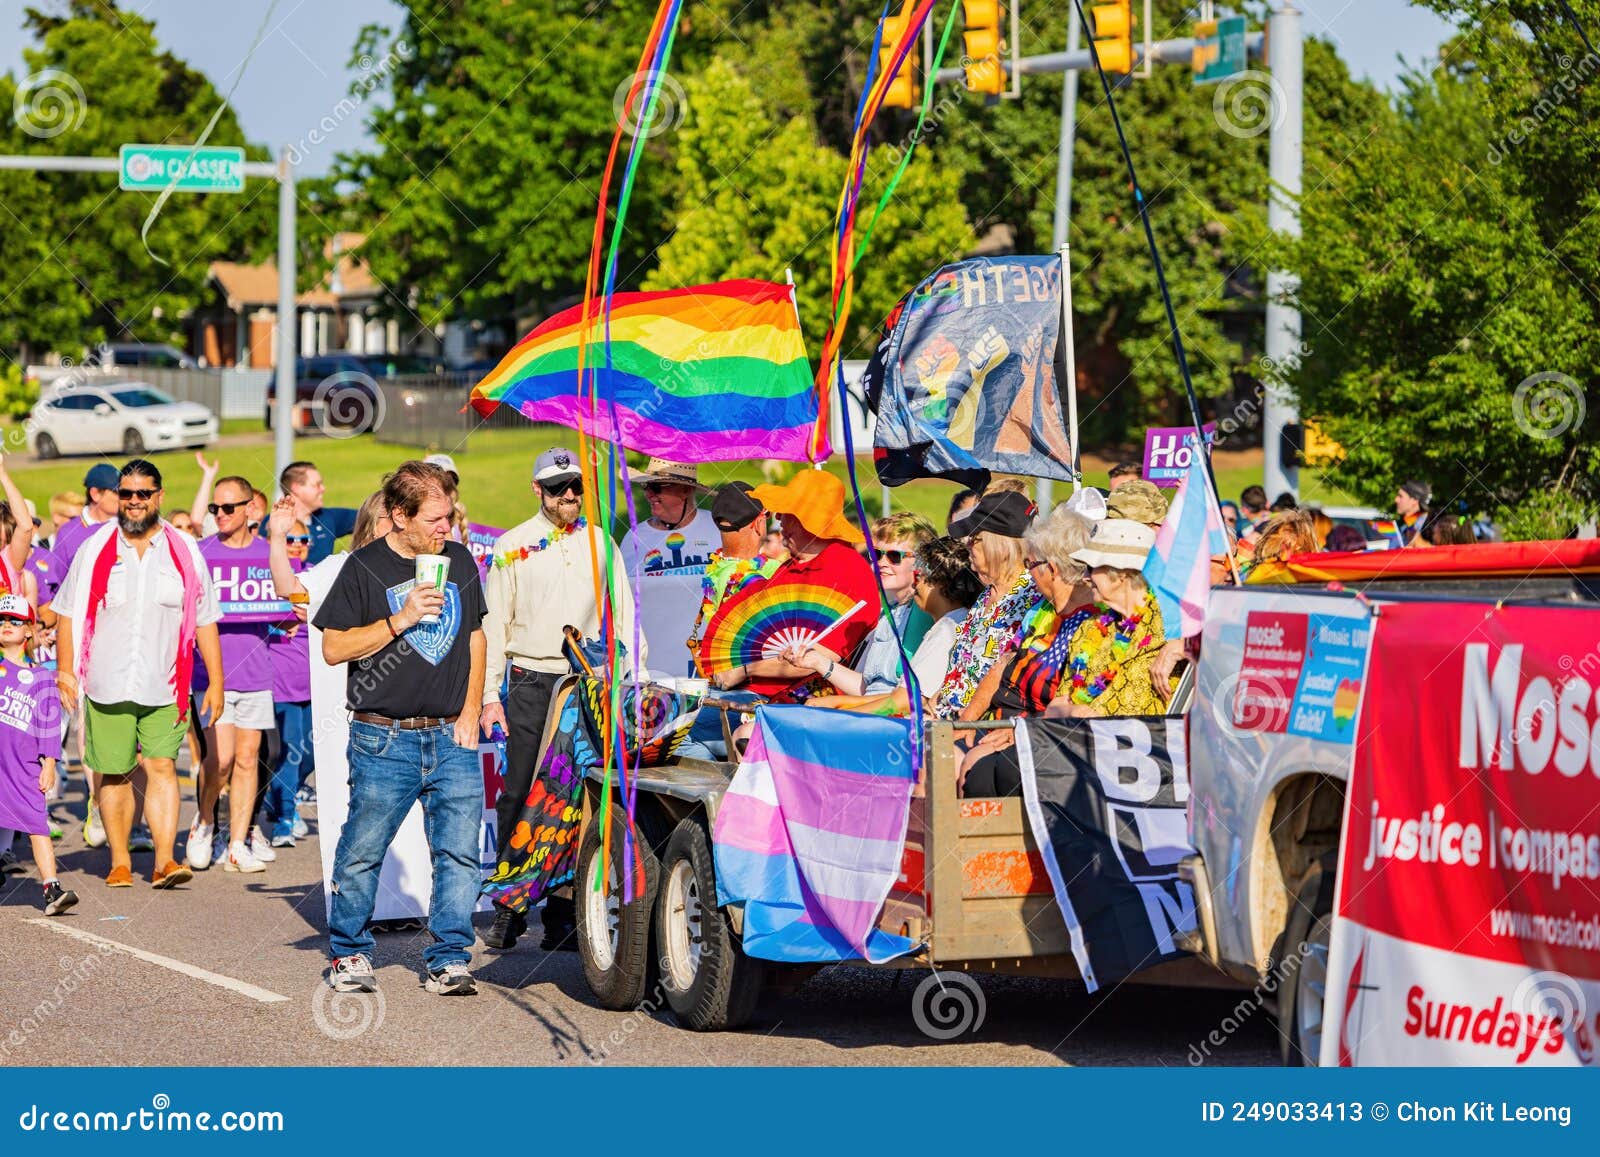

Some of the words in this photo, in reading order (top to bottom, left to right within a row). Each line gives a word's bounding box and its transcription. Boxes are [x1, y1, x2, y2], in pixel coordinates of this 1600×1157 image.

[212, 566, 279, 602] HOR
[248, 602, 280, 612] SENATE
[0, 694, 33, 723] ORN
[4, 686, 37, 708] Kendra
[1363, 799, 1483, 872] justice
[1403, 985, 1565, 1065] Sundays
